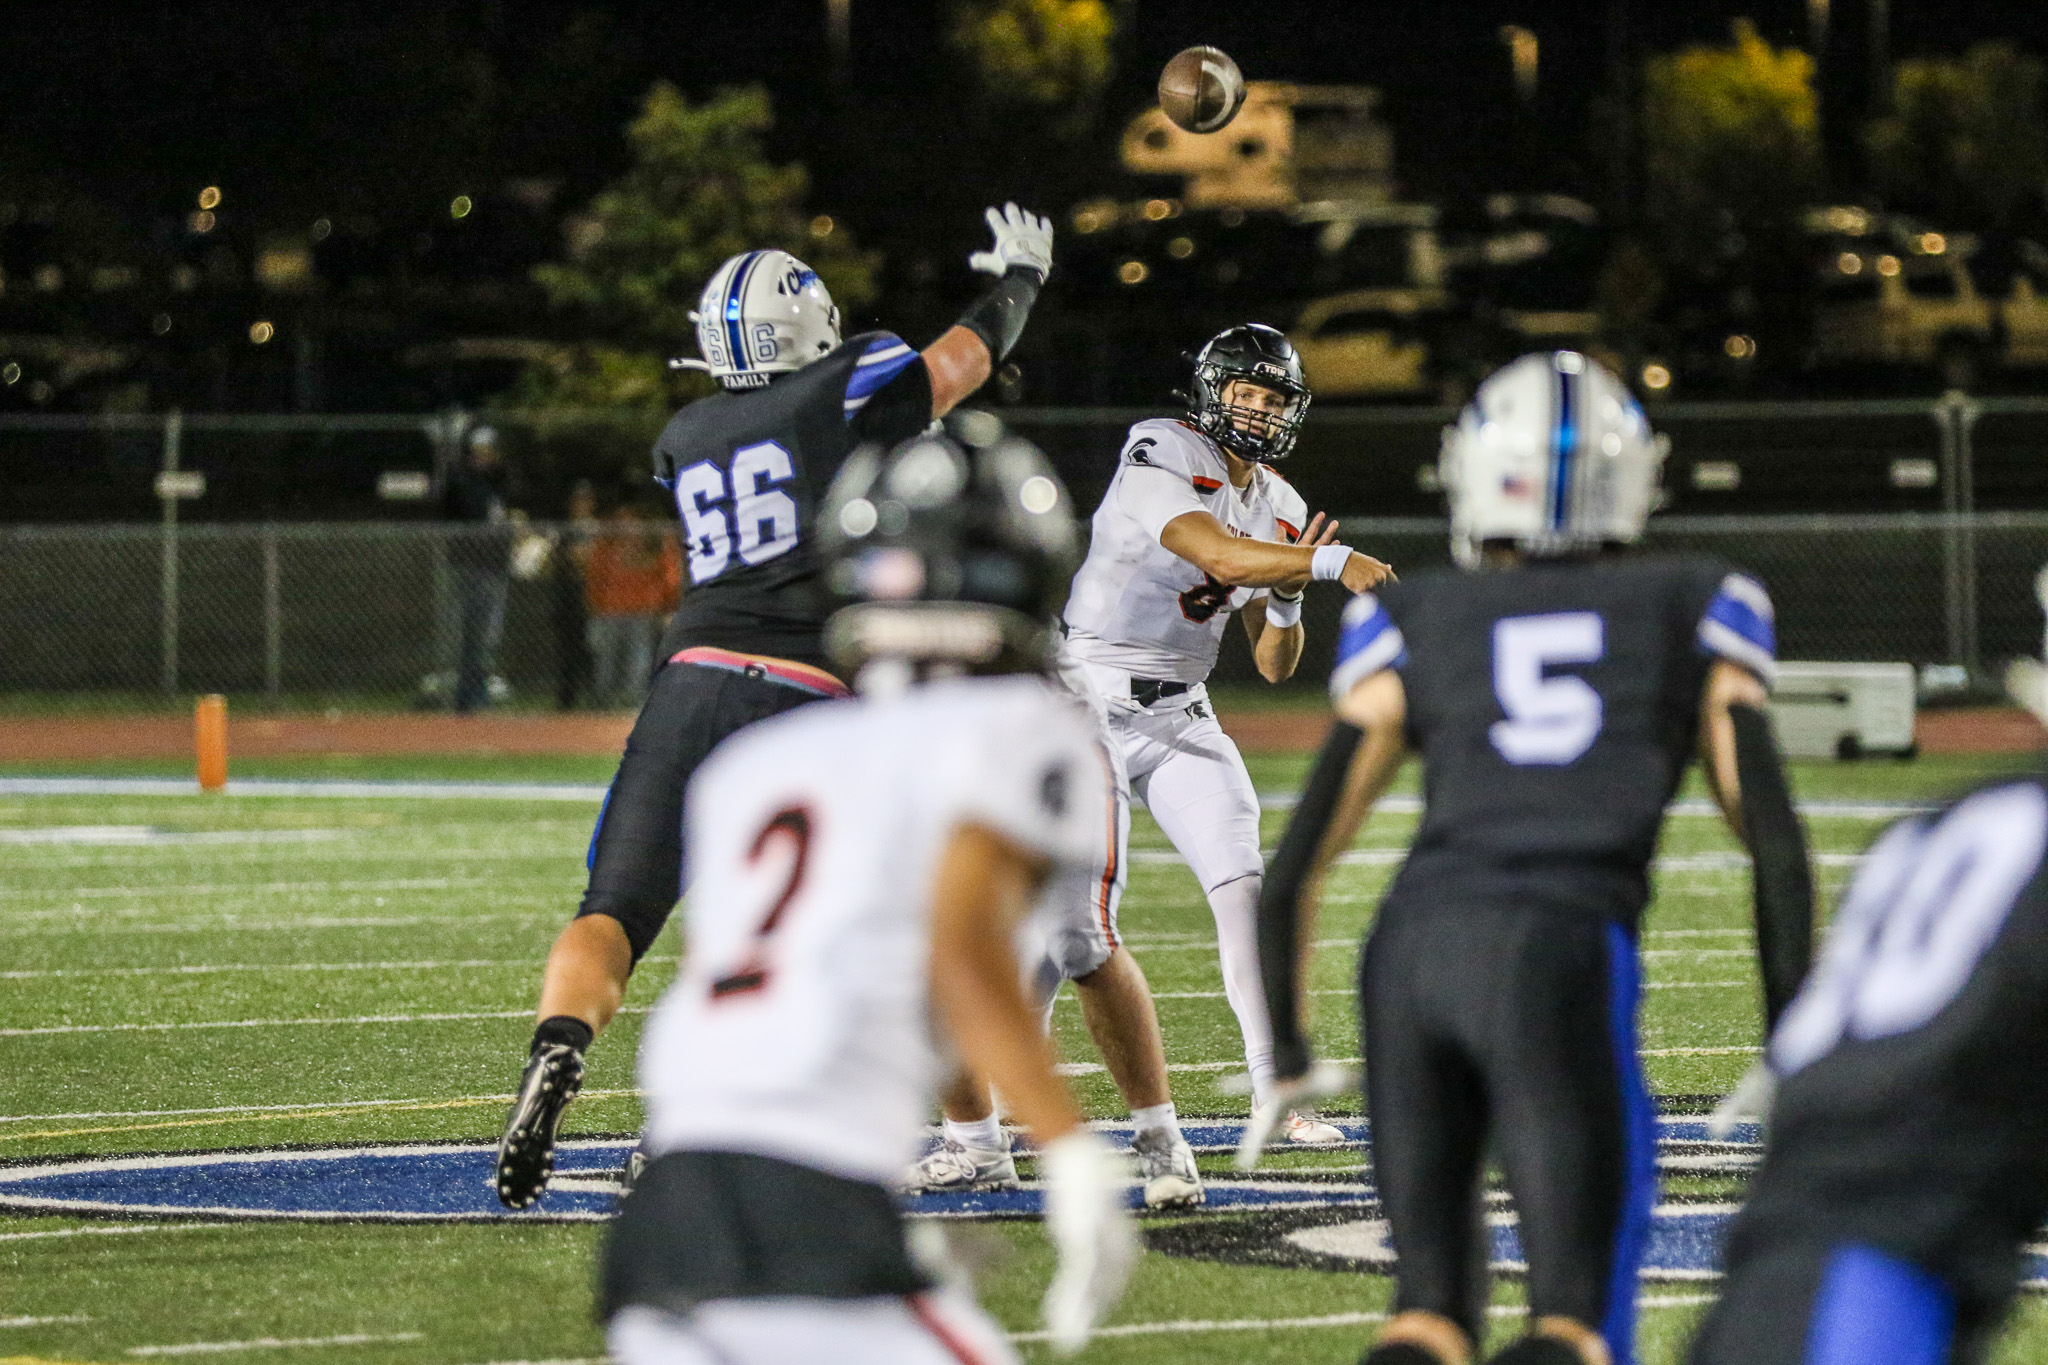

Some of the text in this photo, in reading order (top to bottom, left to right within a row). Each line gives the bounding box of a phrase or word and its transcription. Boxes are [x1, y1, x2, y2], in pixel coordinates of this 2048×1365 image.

[722, 372, 771, 388] FAMILY
[674, 437, 799, 584] 66
[1487, 609, 1606, 768] 5
[706, 803, 812, 1000] 2
